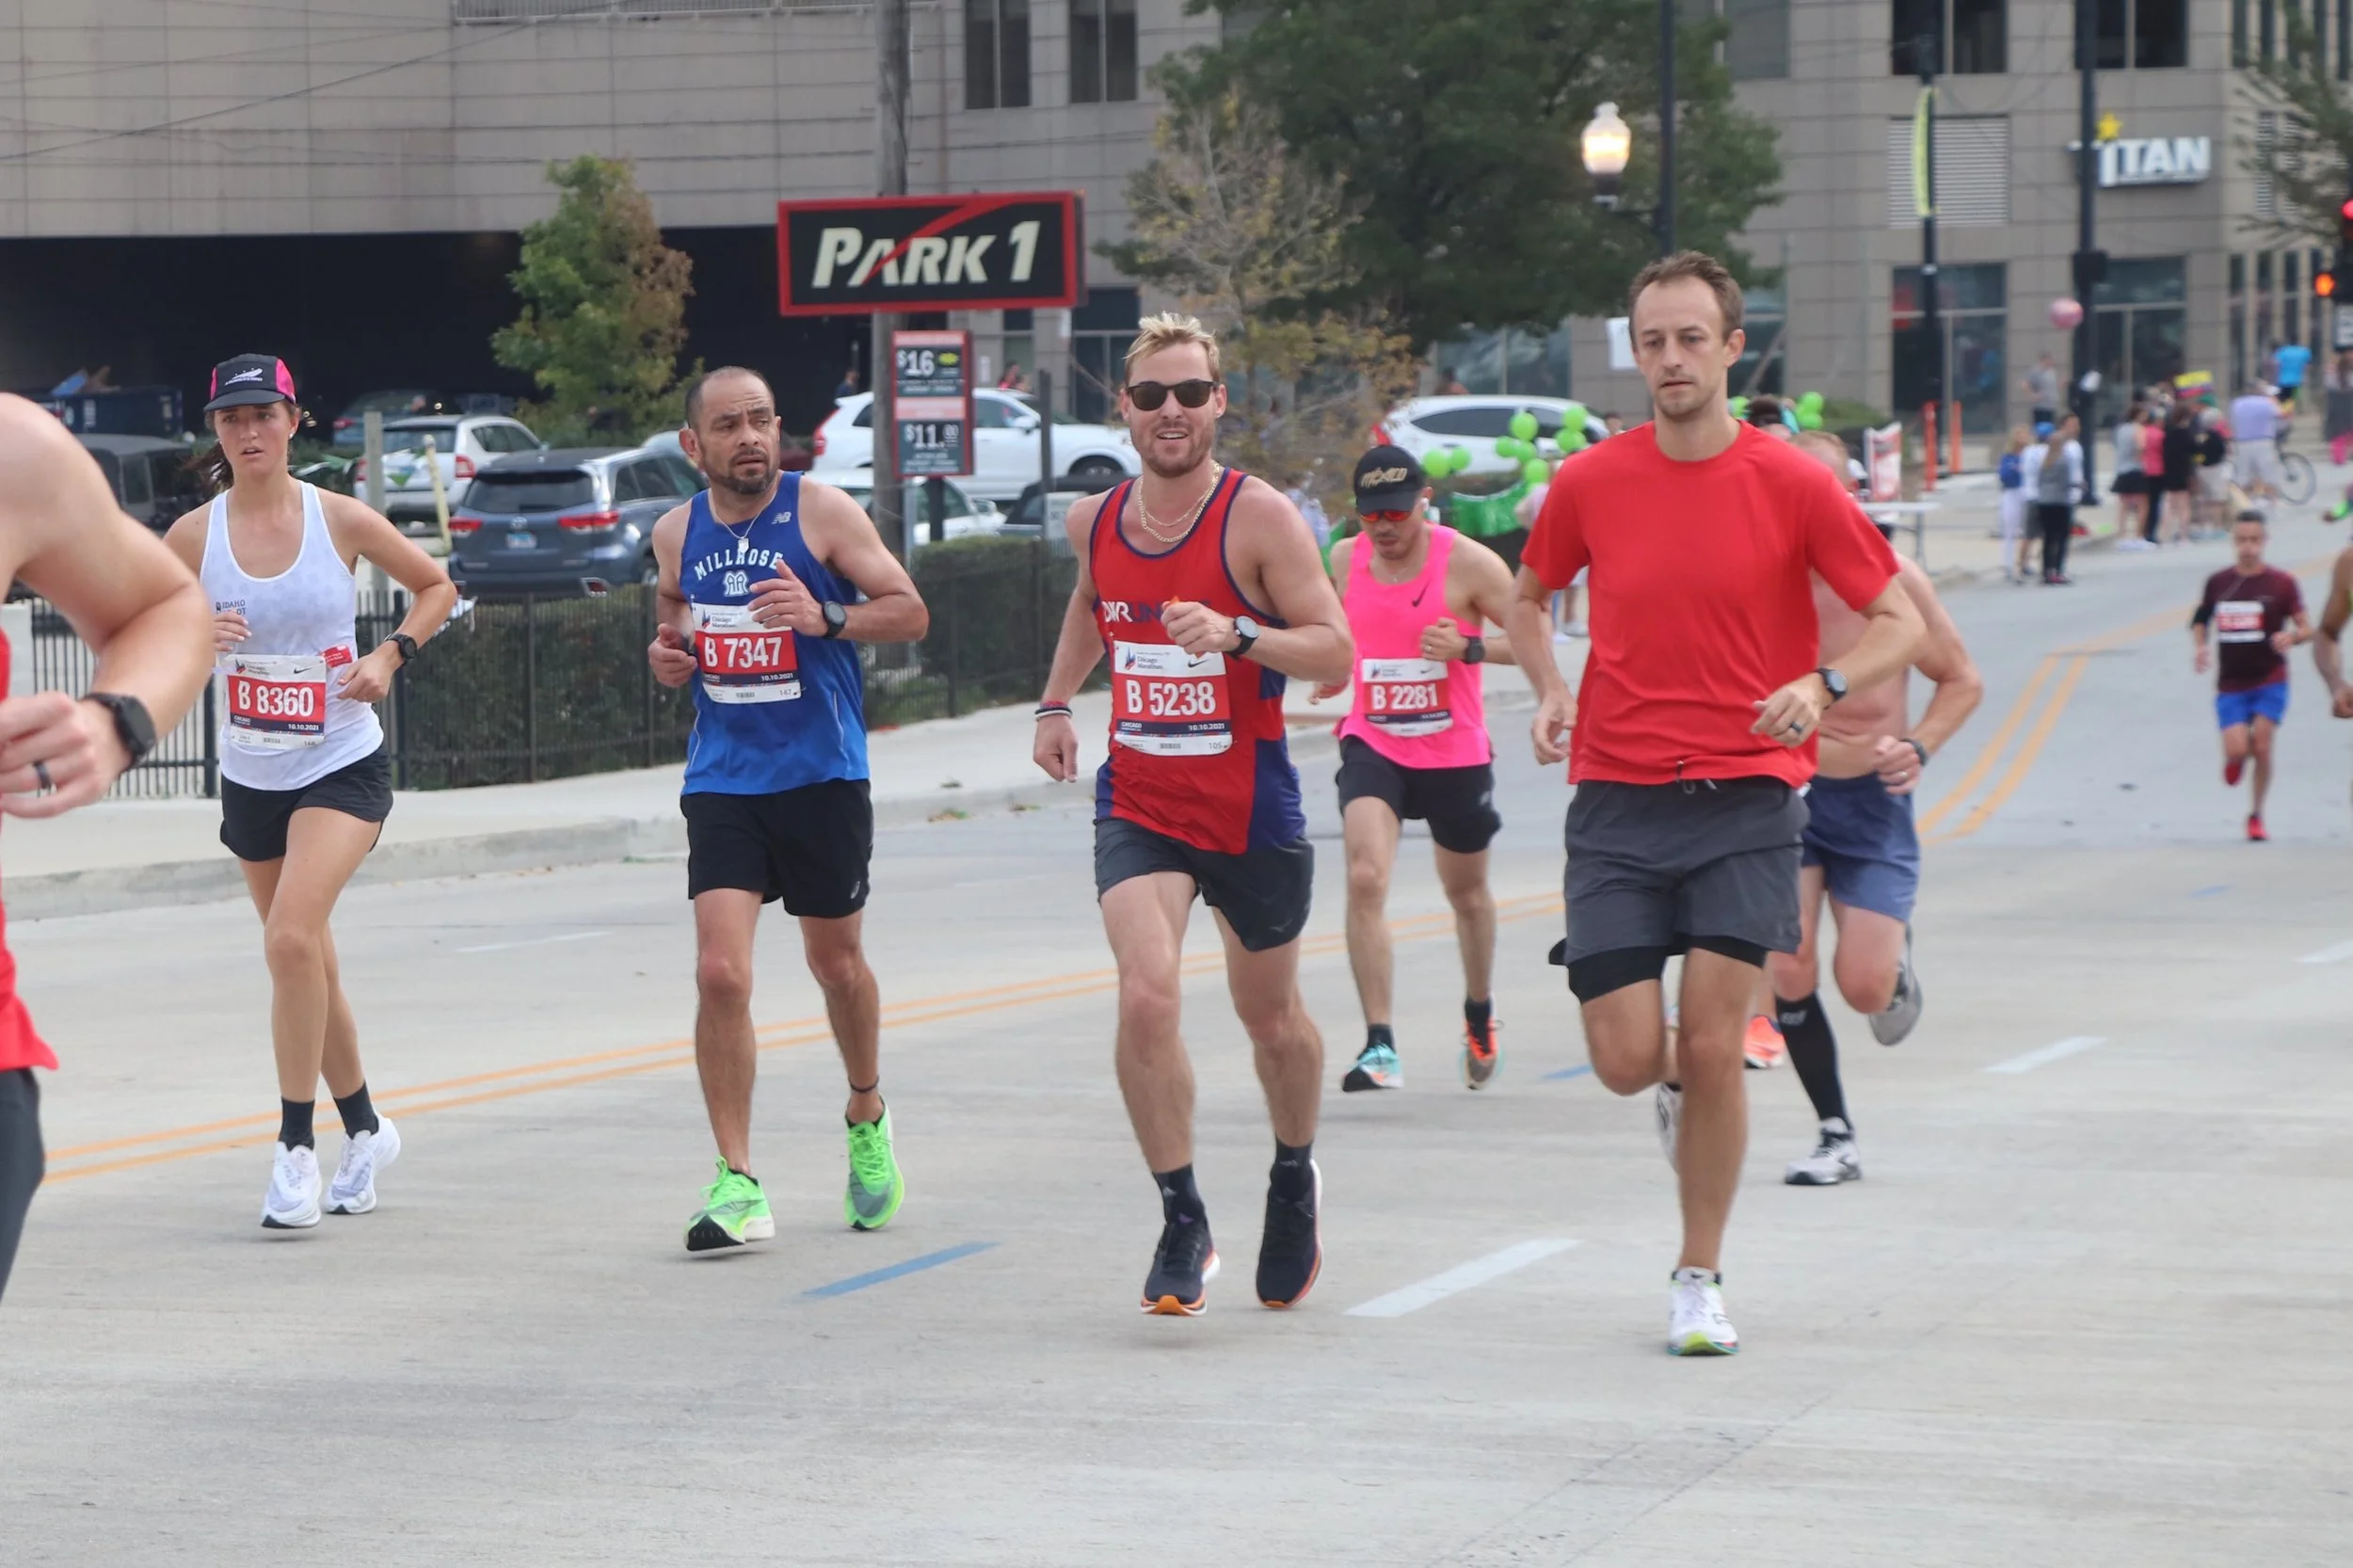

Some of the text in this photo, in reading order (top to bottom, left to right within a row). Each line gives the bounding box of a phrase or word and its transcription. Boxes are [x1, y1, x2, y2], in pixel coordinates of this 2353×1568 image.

[811, 220, 1040, 288] PARK 1
[896, 349, 935, 376] $16
[694, 548, 784, 581] MILLROSE
[222, 600, 246, 609] IDAHO
[704, 636, 782, 669] B 7347
[760, 672, 793, 681] 10.10.2021
[238, 680, 313, 717] B 8360
[1126, 680, 1216, 716] B 5238
[1371, 682, 1438, 711] B 2281
[288, 723, 319, 731] 10.10.2021
[1189, 723, 1225, 731] 10.10.2021
